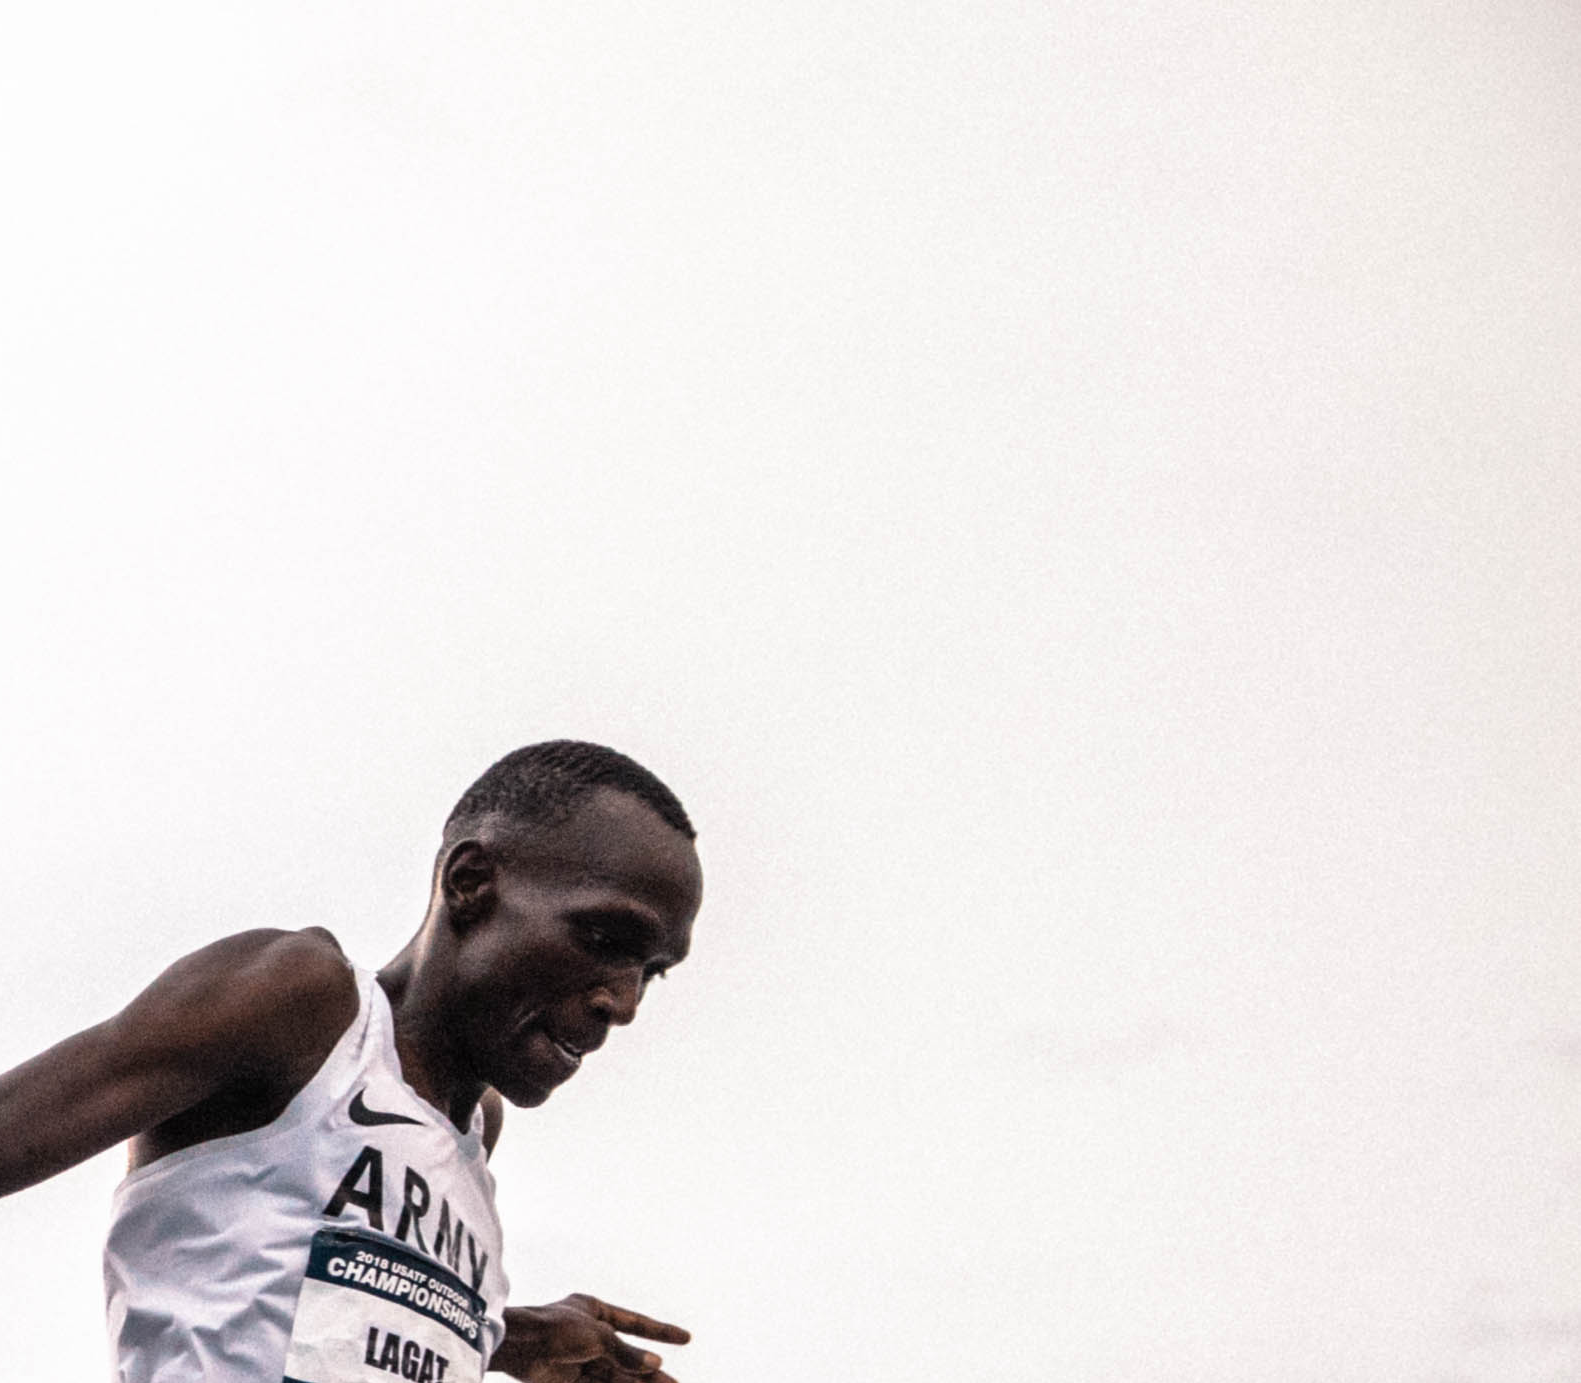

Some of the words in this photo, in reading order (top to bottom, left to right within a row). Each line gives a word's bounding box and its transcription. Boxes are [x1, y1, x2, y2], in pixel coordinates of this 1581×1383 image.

[322, 1145, 488, 1292] ARMY
[327, 1257, 478, 1339] CHAMPIONSHIPS
[356, 1251, 389, 1269] 2018
[391, 1261, 428, 1282] USATF
[428, 1277, 471, 1308] OUTDOOR
